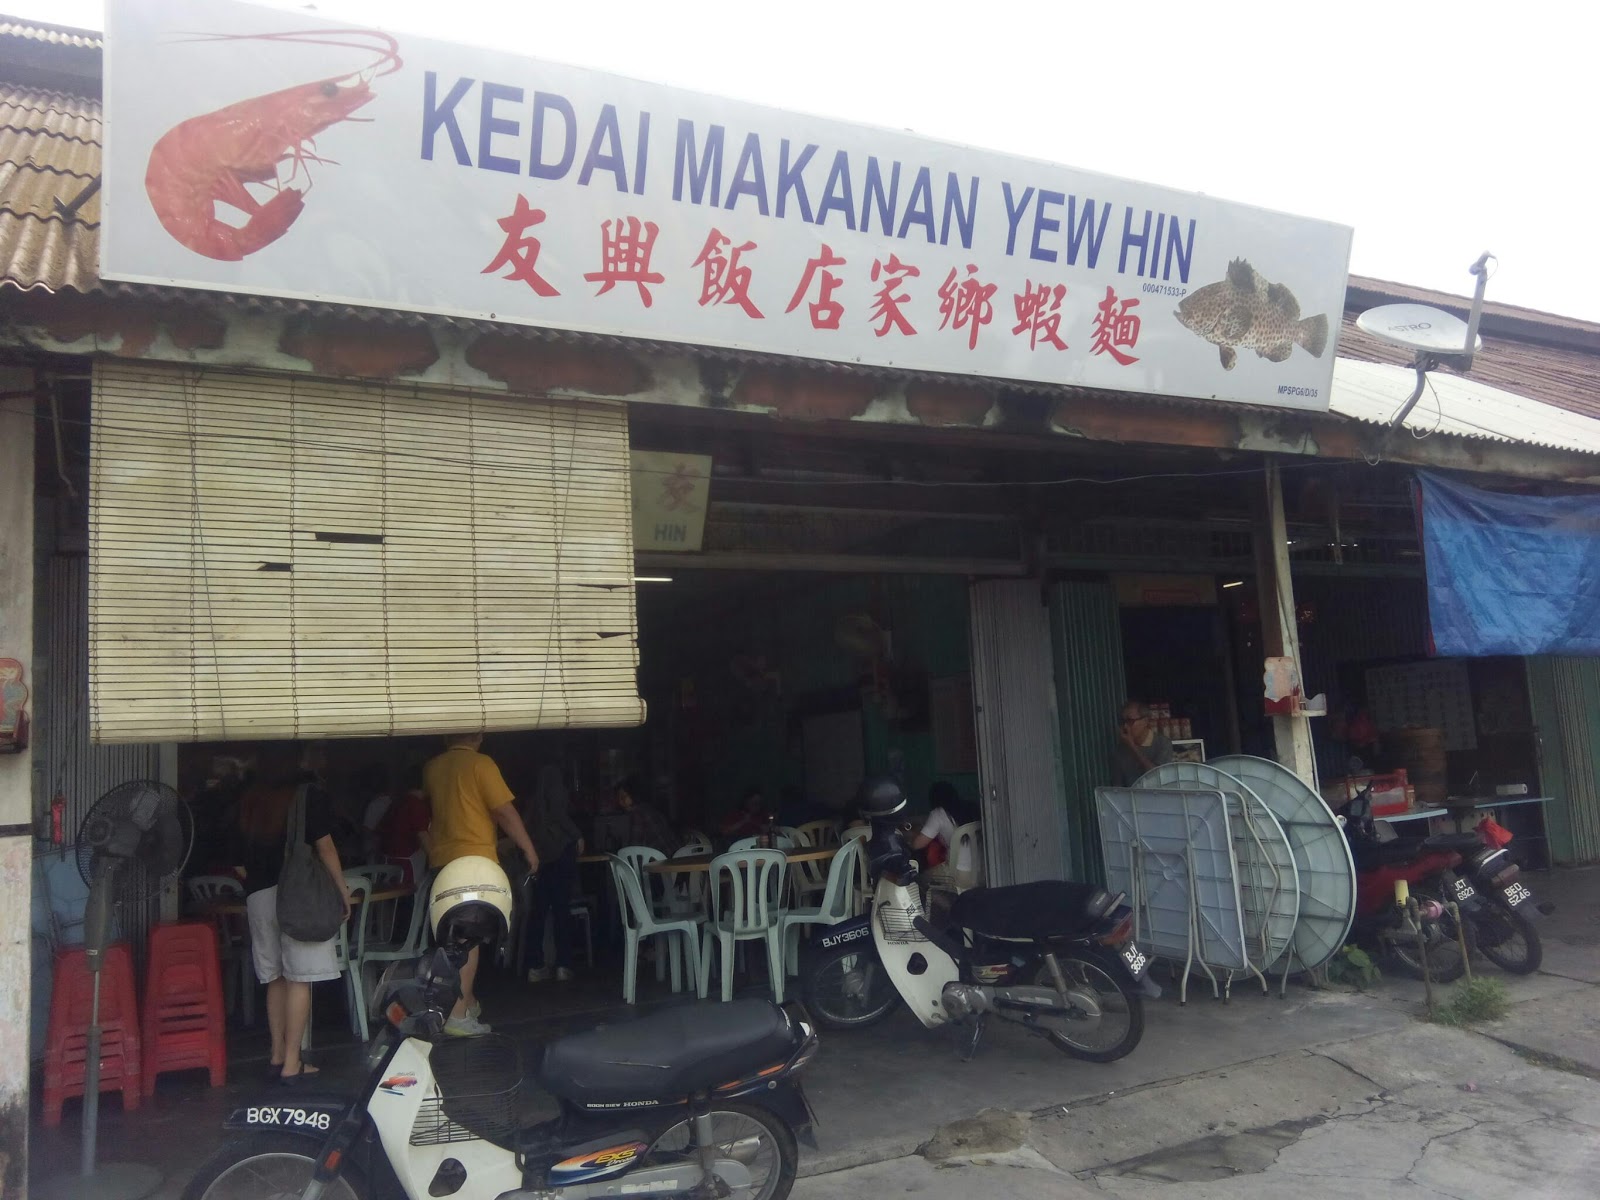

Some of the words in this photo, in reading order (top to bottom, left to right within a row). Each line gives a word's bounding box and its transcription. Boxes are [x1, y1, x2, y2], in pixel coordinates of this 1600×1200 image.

[420, 71, 651, 196] KEDAI
[672, 118, 980, 249] MAKANAN
[1001, 181, 1112, 269] YEW
[1117, 206, 1197, 284] HIN
[1142, 282, 1187, 297] 000471533-P
[1387, 322, 1432, 332] ASTRO
[655, 523, 688, 543] HIN
[1456, 886, 1475, 901] 6923
[1507, 888, 1531, 907] 5246
[822, 926, 870, 948] BJY3606
[623, 1099, 660, 1107] HONDA
